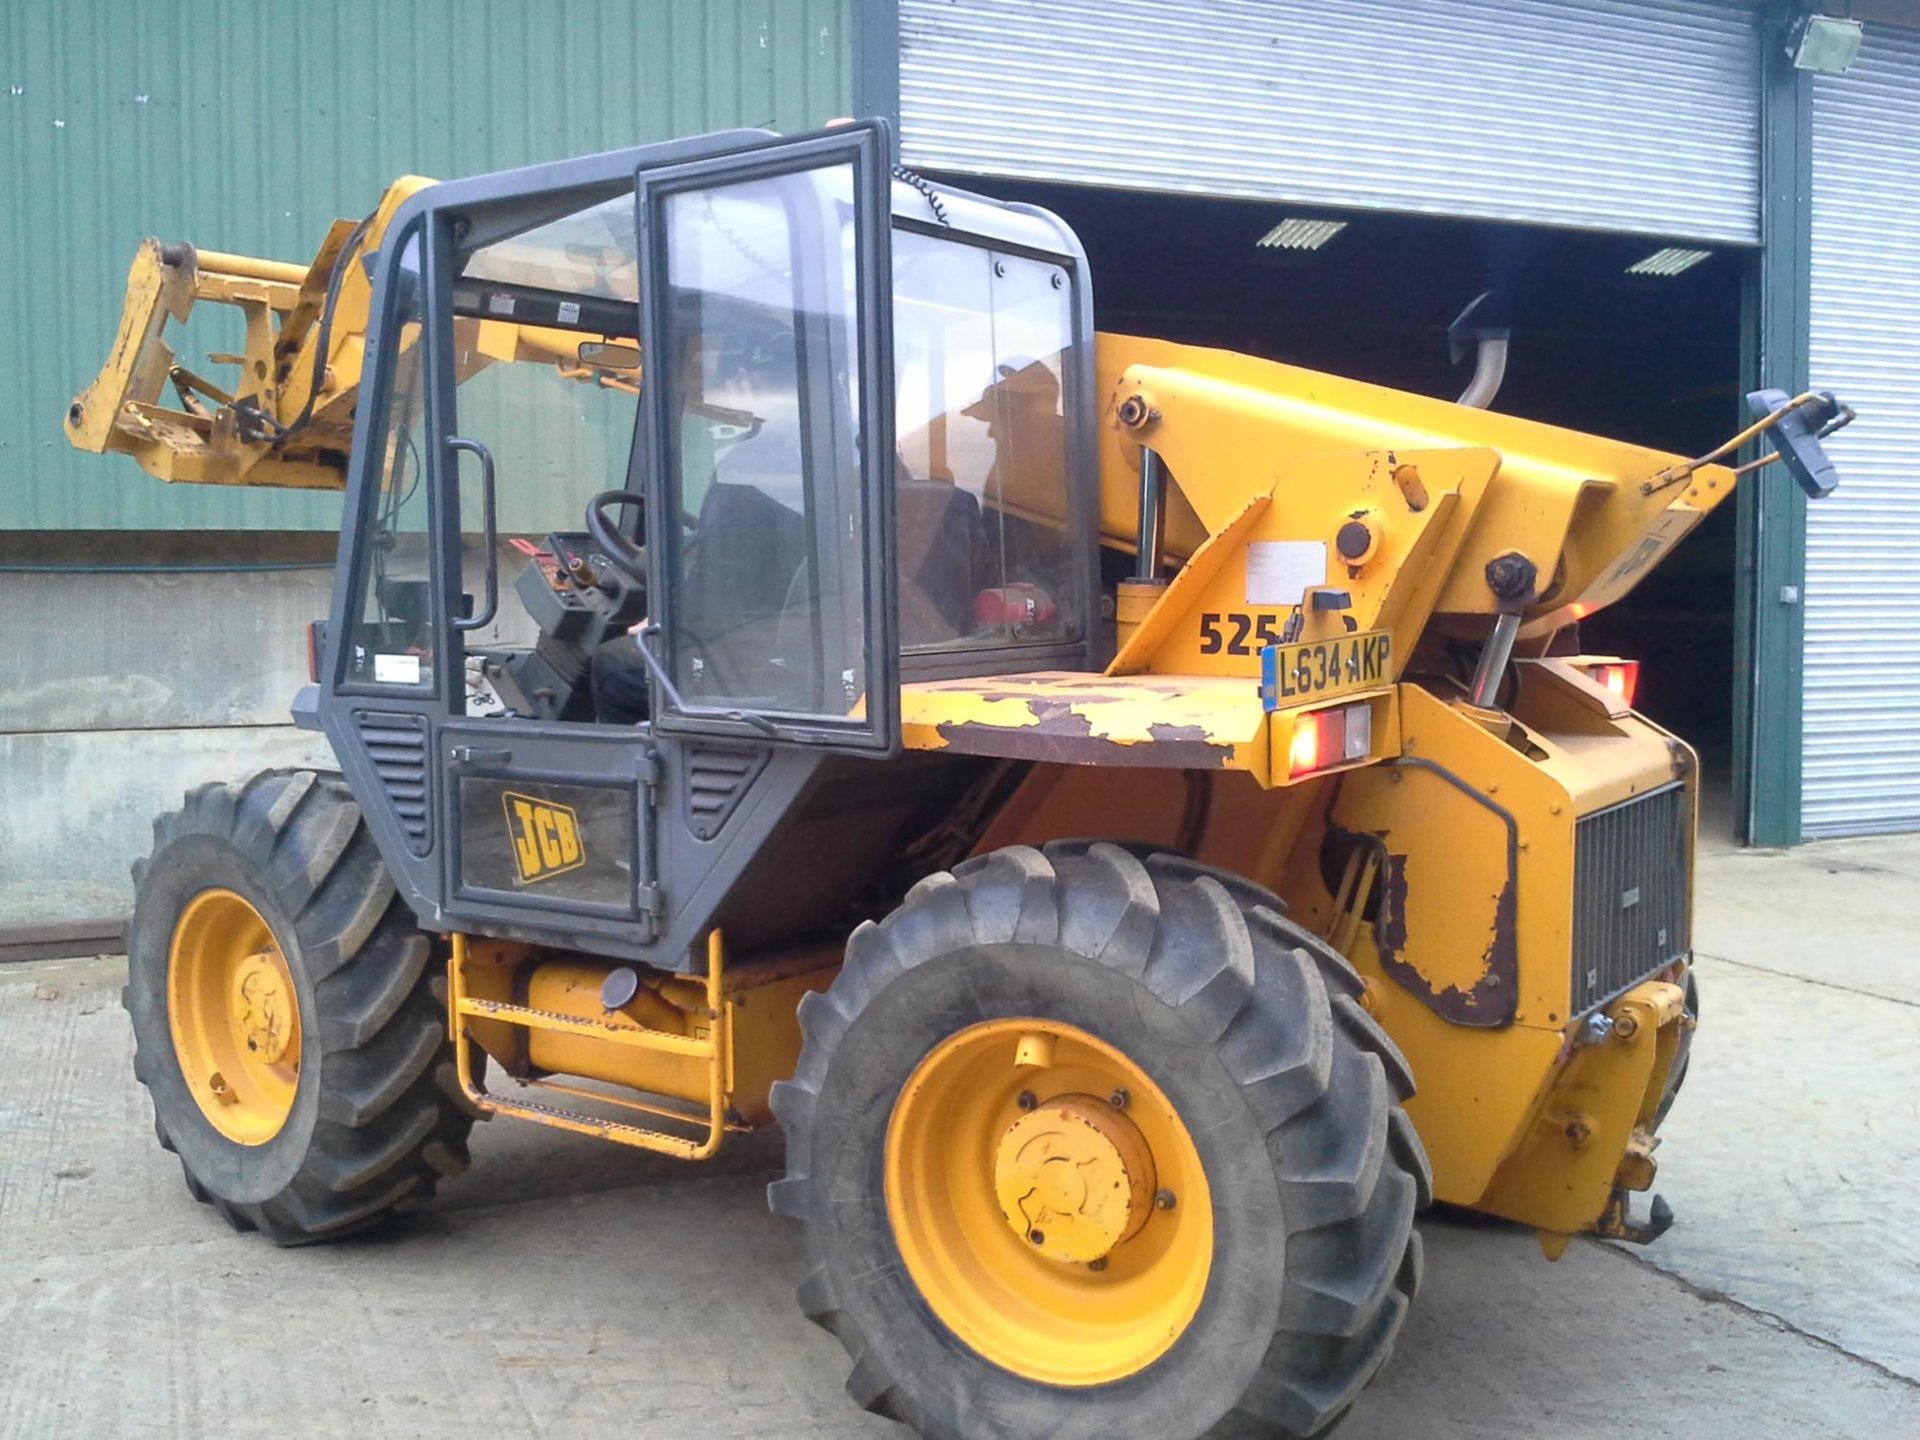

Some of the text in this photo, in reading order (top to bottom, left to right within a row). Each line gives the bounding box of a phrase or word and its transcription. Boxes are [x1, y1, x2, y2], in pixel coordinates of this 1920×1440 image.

[1281, 635, 1390, 697] L634 AKP
[514, 800, 578, 877] JCB
